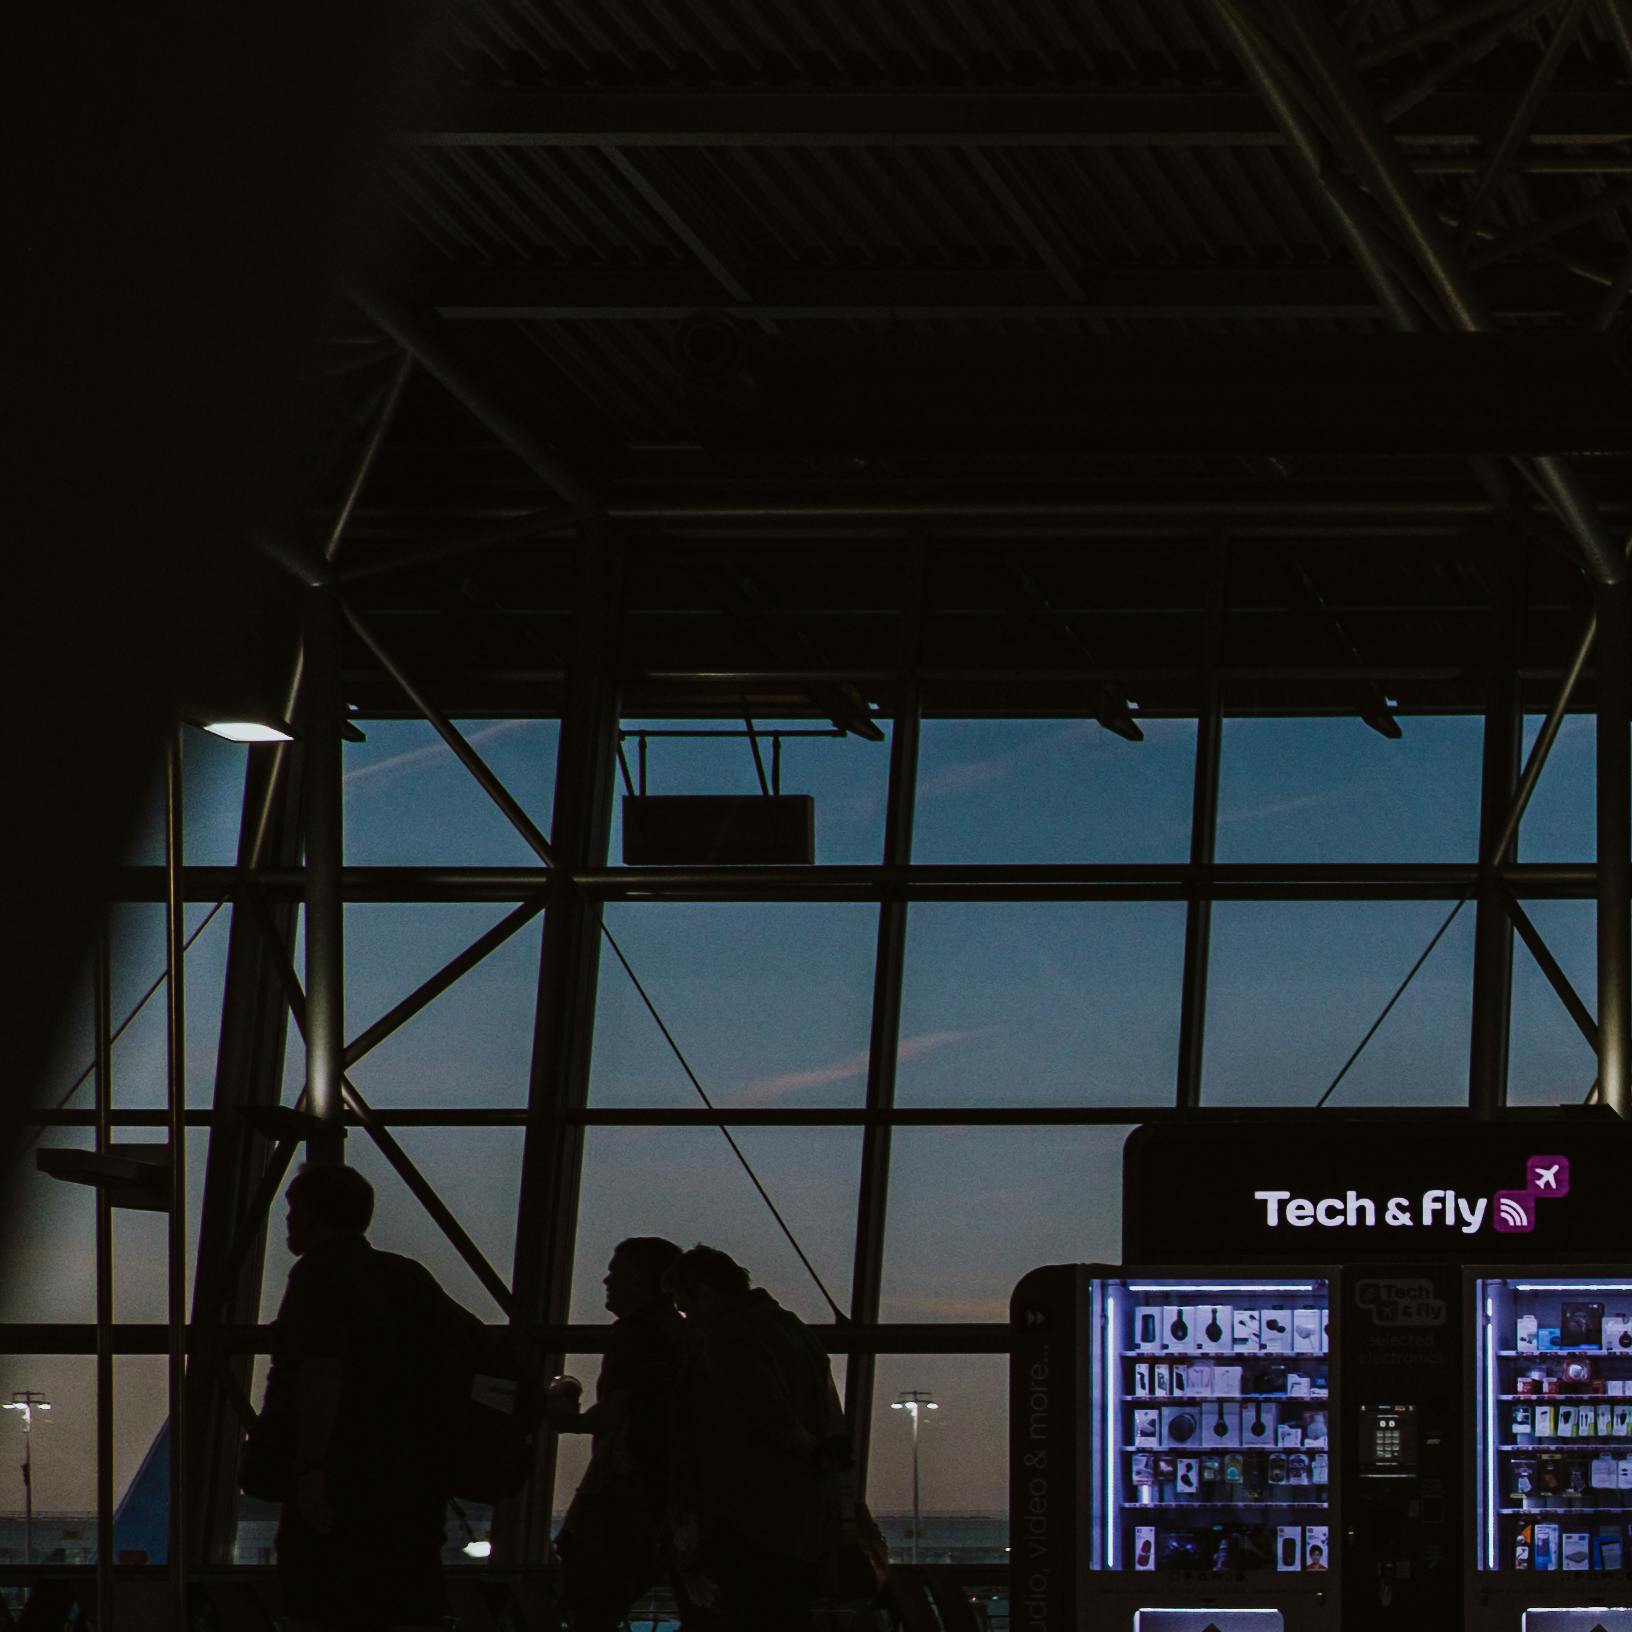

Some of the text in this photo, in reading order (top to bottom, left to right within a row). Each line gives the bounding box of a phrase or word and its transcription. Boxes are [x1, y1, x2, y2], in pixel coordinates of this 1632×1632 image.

[1254, 1190, 1375, 1227] Tech
[1384, 1197, 1413, 1226] &
[1382, 1285, 1430, 1299] Tech
[1024, 1451, 1047, 1470] &
[1023, 1477, 1048, 1559] video
